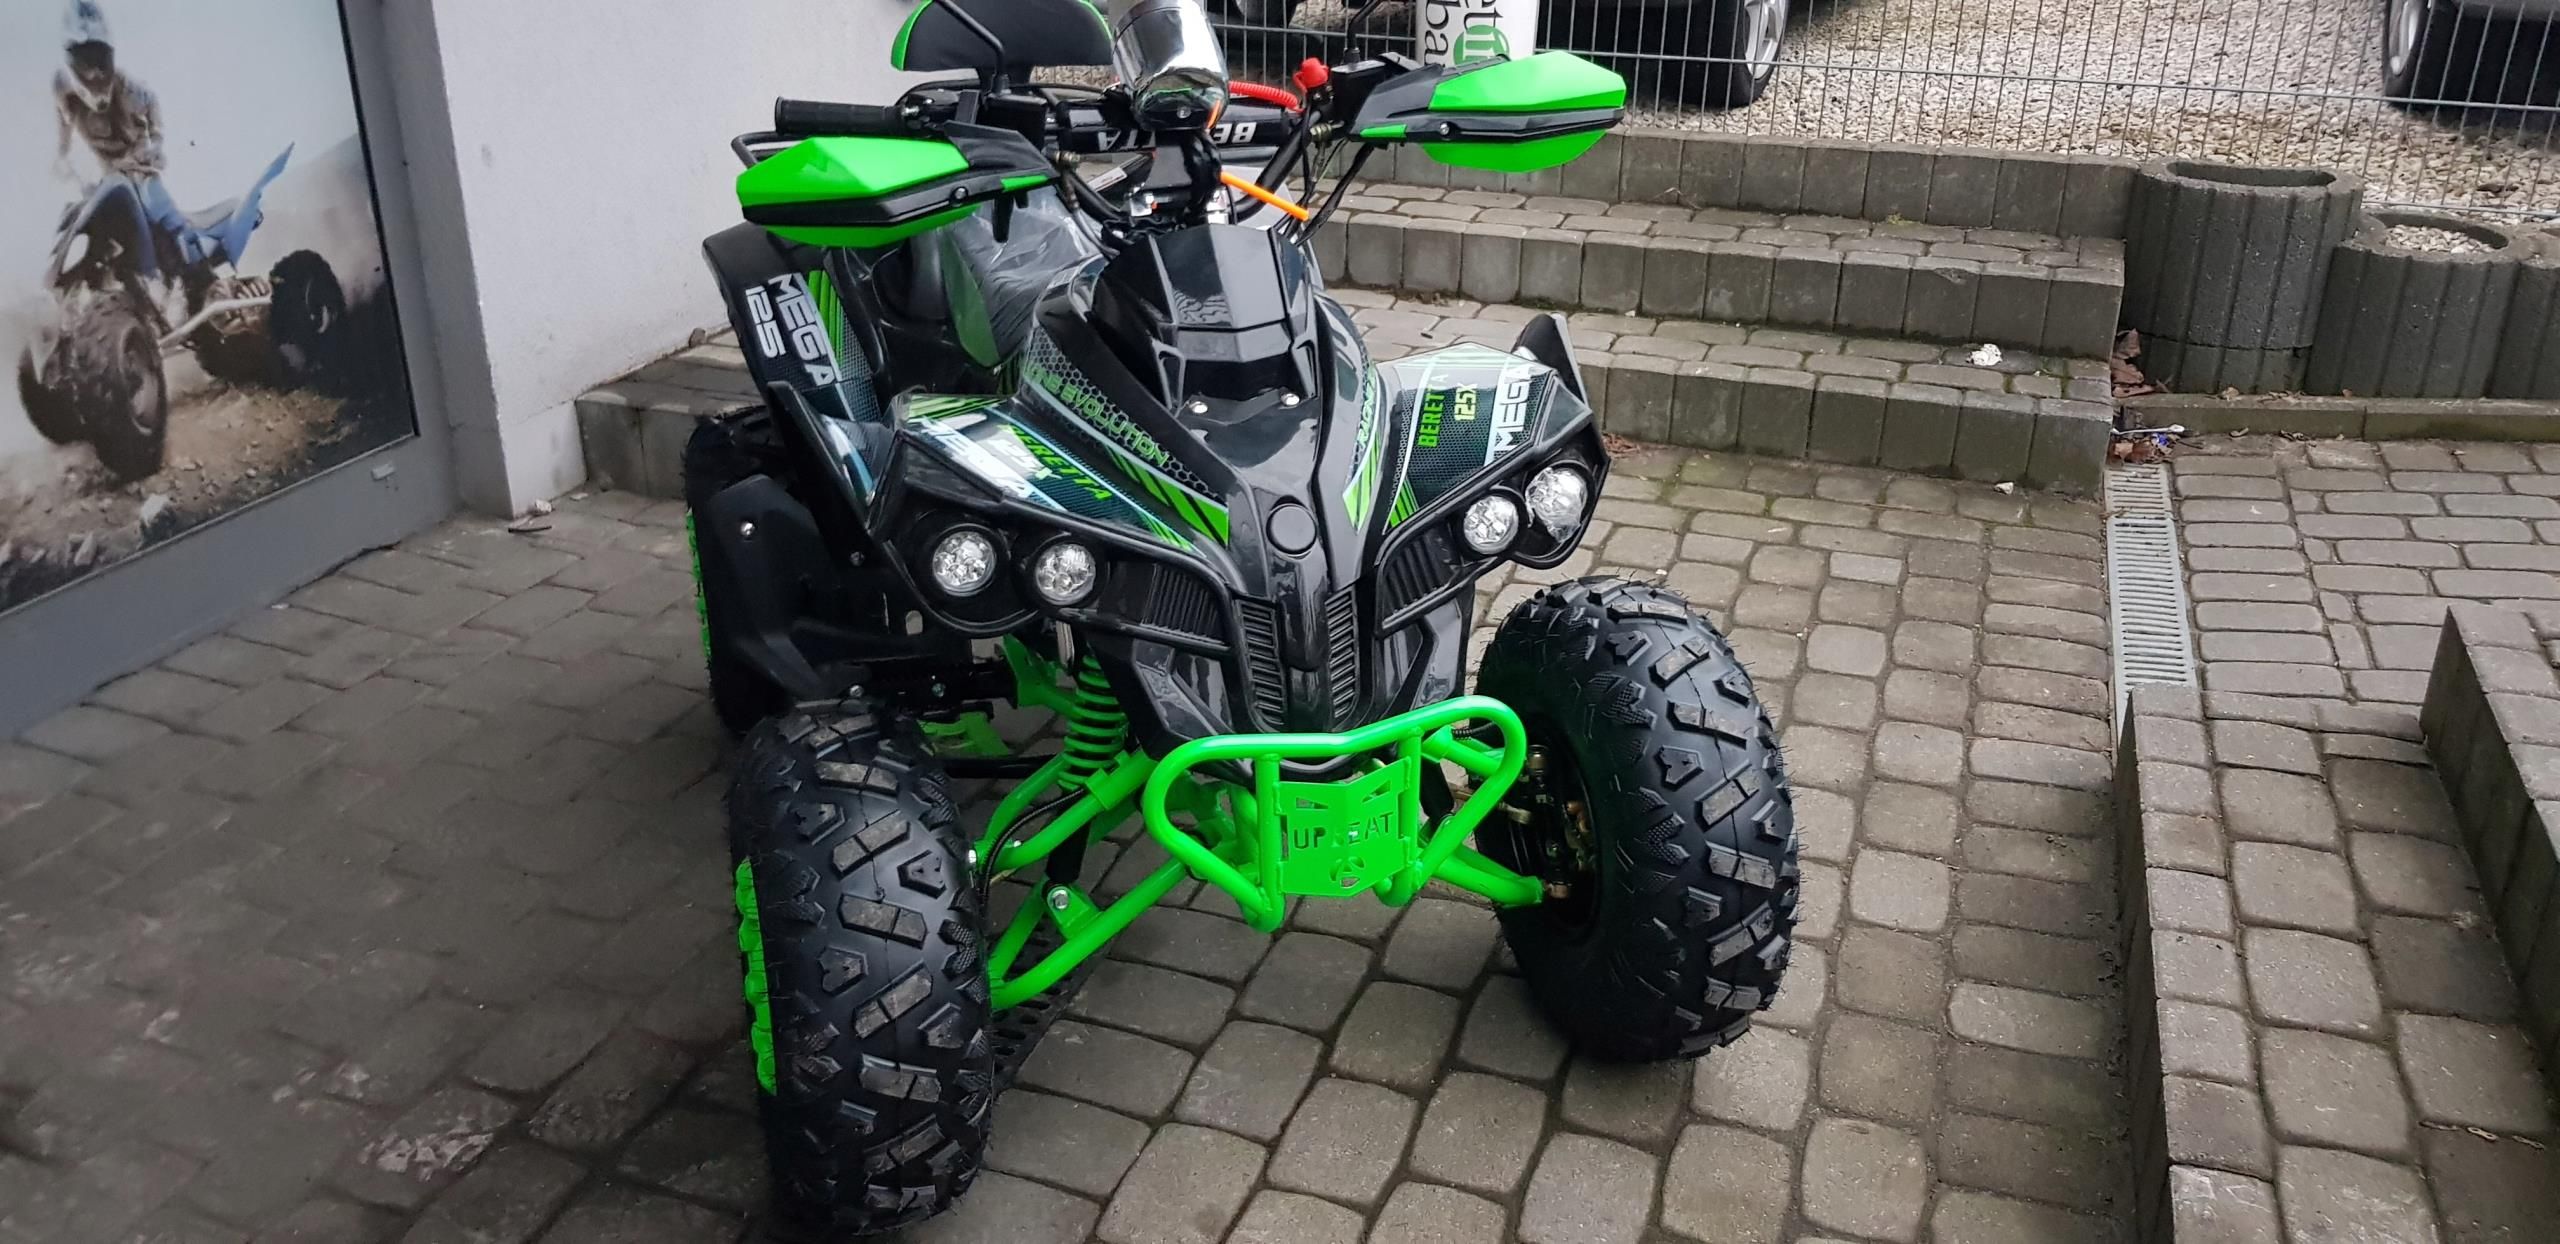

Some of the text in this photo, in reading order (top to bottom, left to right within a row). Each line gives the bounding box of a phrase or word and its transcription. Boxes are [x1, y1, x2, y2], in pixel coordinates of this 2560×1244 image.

[745, 285, 787, 358] 125
[768, 272, 836, 387] MEGA
[1060, 383, 1169, 467] EVOLUTION
[1417, 374, 1448, 447] BERETTA
[1454, 383, 1477, 421] 125X
[1494, 362, 1532, 451] MEGA
